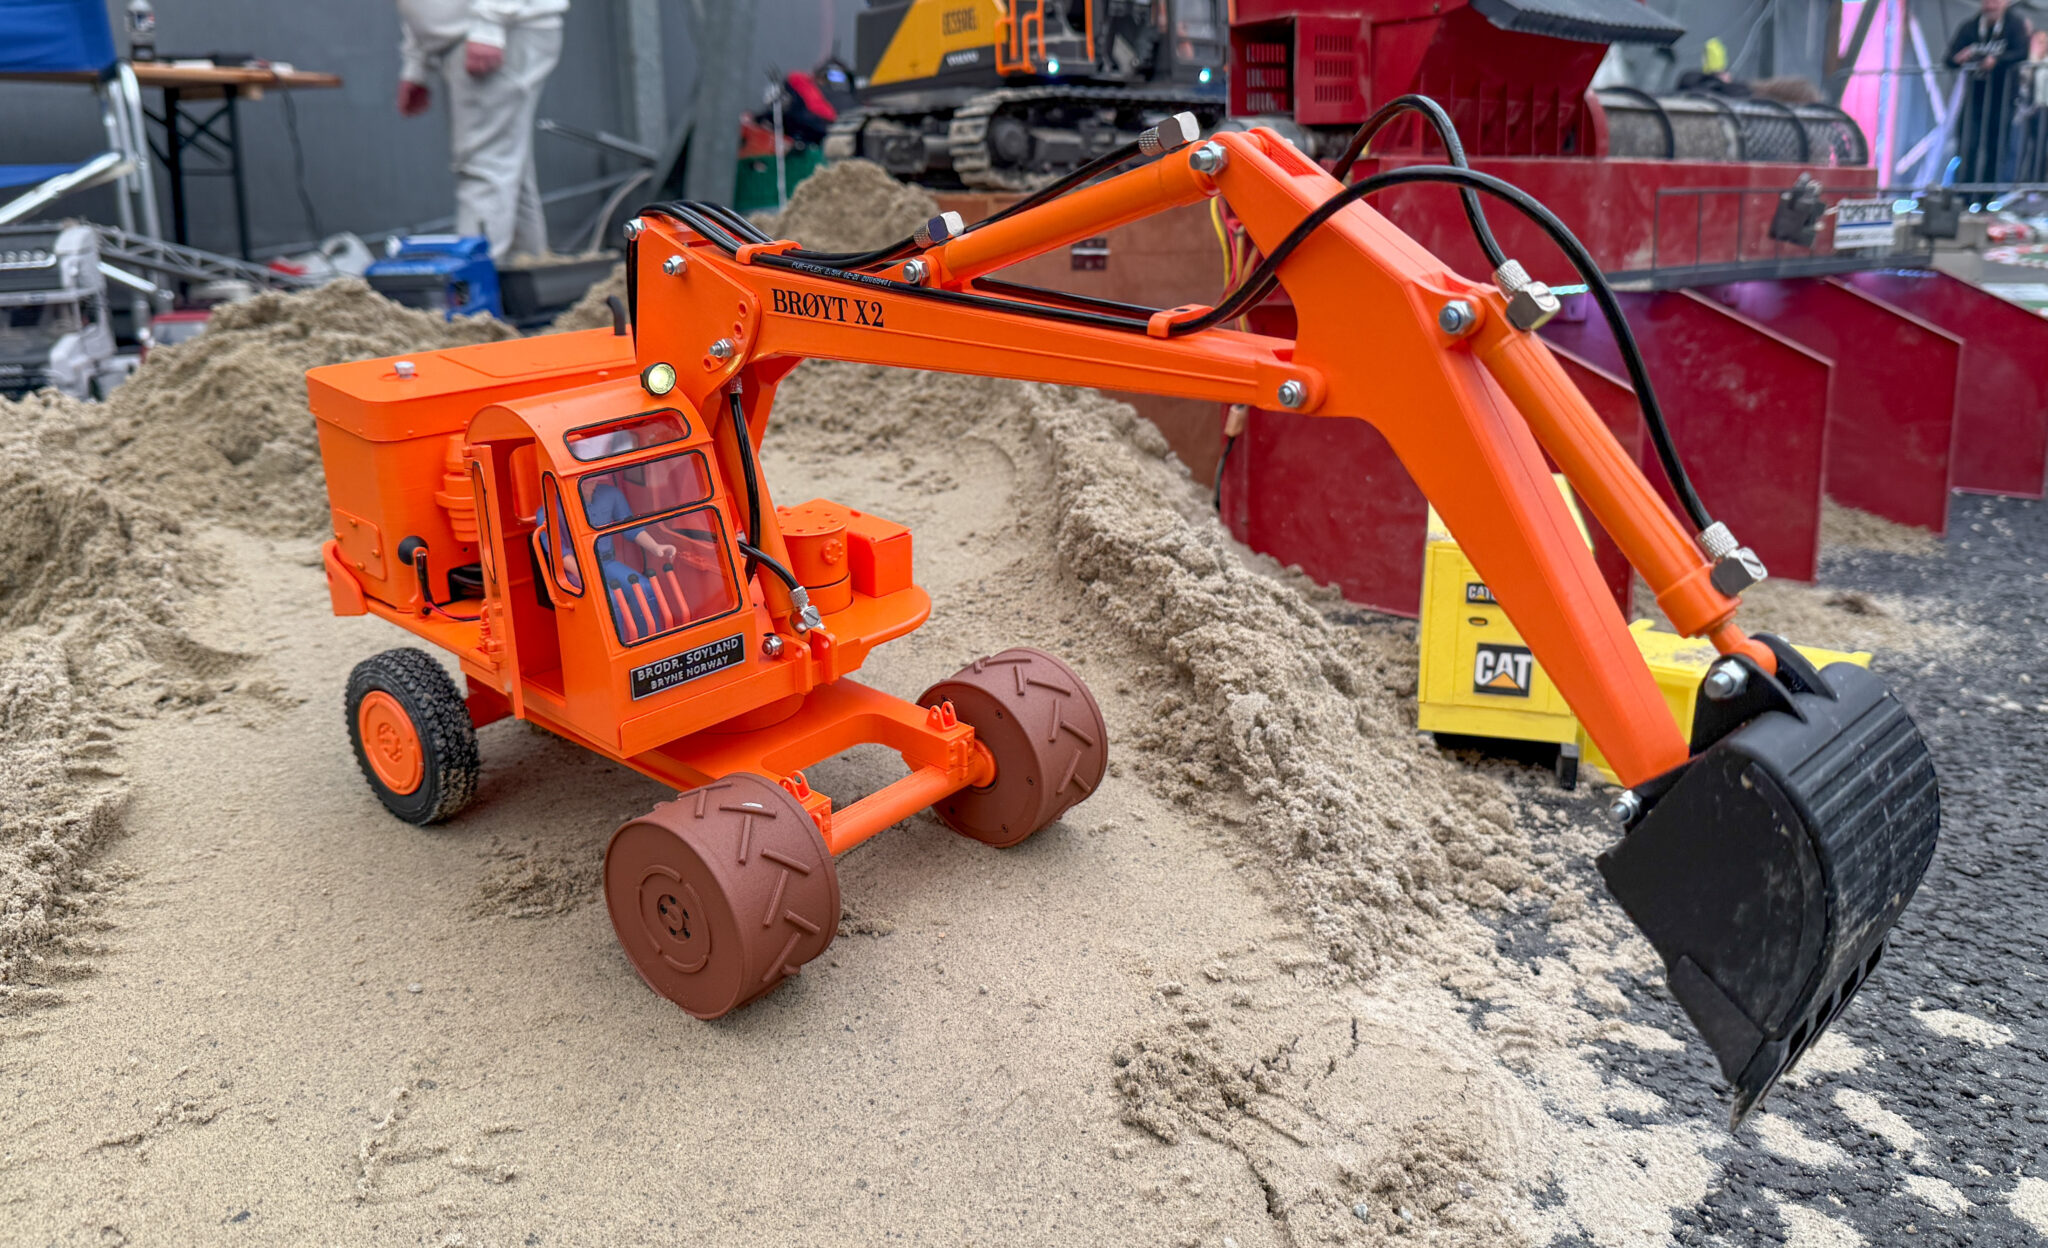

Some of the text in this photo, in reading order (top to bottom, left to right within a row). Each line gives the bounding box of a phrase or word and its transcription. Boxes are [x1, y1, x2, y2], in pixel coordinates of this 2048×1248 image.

[771, 288, 884, 328] BRØYT X2
[650, 655, 729, 690] BRYNE NORWAY
[1474, 650, 1533, 690] CAT
